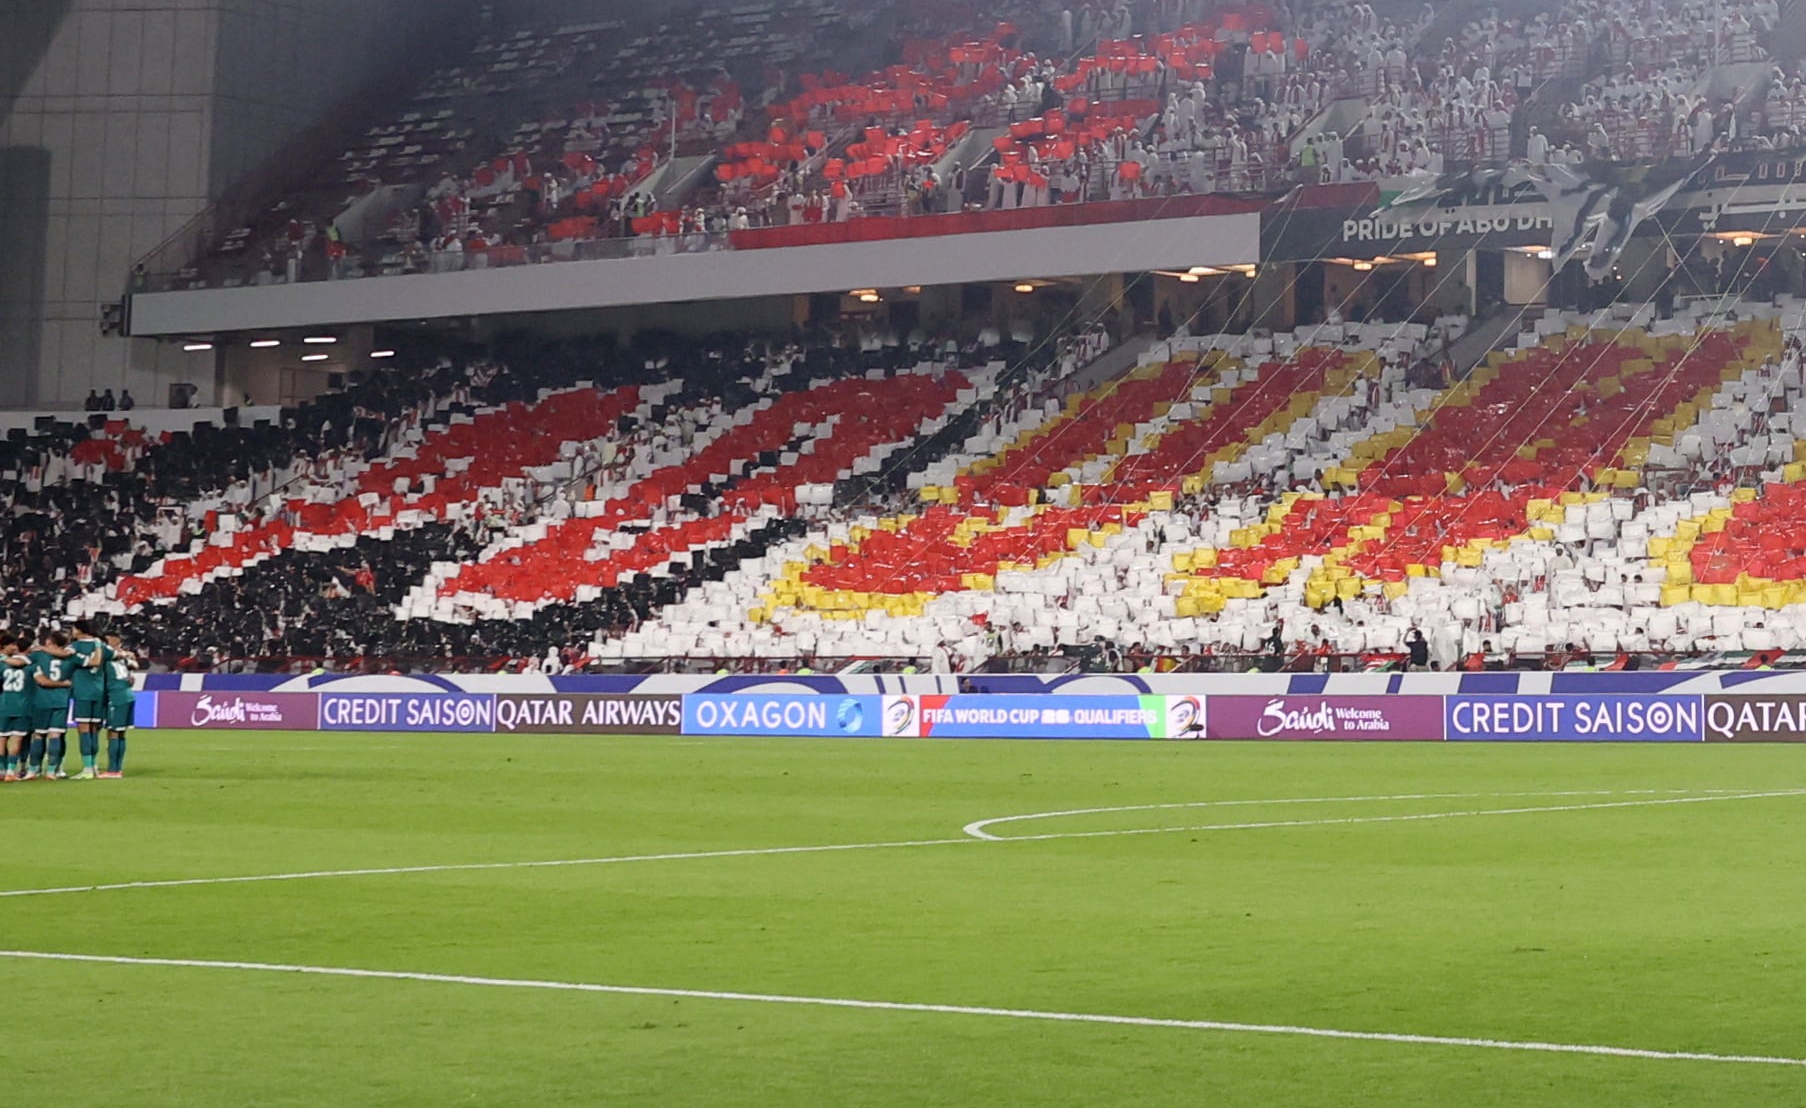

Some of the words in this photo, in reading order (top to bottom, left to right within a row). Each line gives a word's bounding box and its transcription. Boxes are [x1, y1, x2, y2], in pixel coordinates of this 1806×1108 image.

[1342, 218, 1414, 242] PRIDE
[2, 668, 25, 692] 23
[49, 659, 62, 681] 5
[191, 693, 246, 726] Saudi
[245, 702, 279, 713] Welcome
[250, 712, 259, 722] to
[259, 712, 283, 722] Arabia
[323, 698, 402, 725] CREDIT
[406, 699, 491, 726] SAISON
[496, 699, 574, 730] QATAR
[581, 699, 681, 726] AIRWAYS
[695, 700, 826, 730] OXAGON
[922, 709, 953, 724] FIFA
[956, 709, 1008, 724] WORLD
[1009, 709, 1039, 724] CUP
[1074, 709, 1158, 725] QUALIFIERS
[1257, 699, 1336, 736] Saudi
[1335, 707, 1382, 719] Welcome
[1452, 701, 1565, 734] CREDIT
[1574, 701, 1697, 734] SAISON
[1343, 719, 1355, 731] to
[1355, 719, 1390, 731] Arabia
